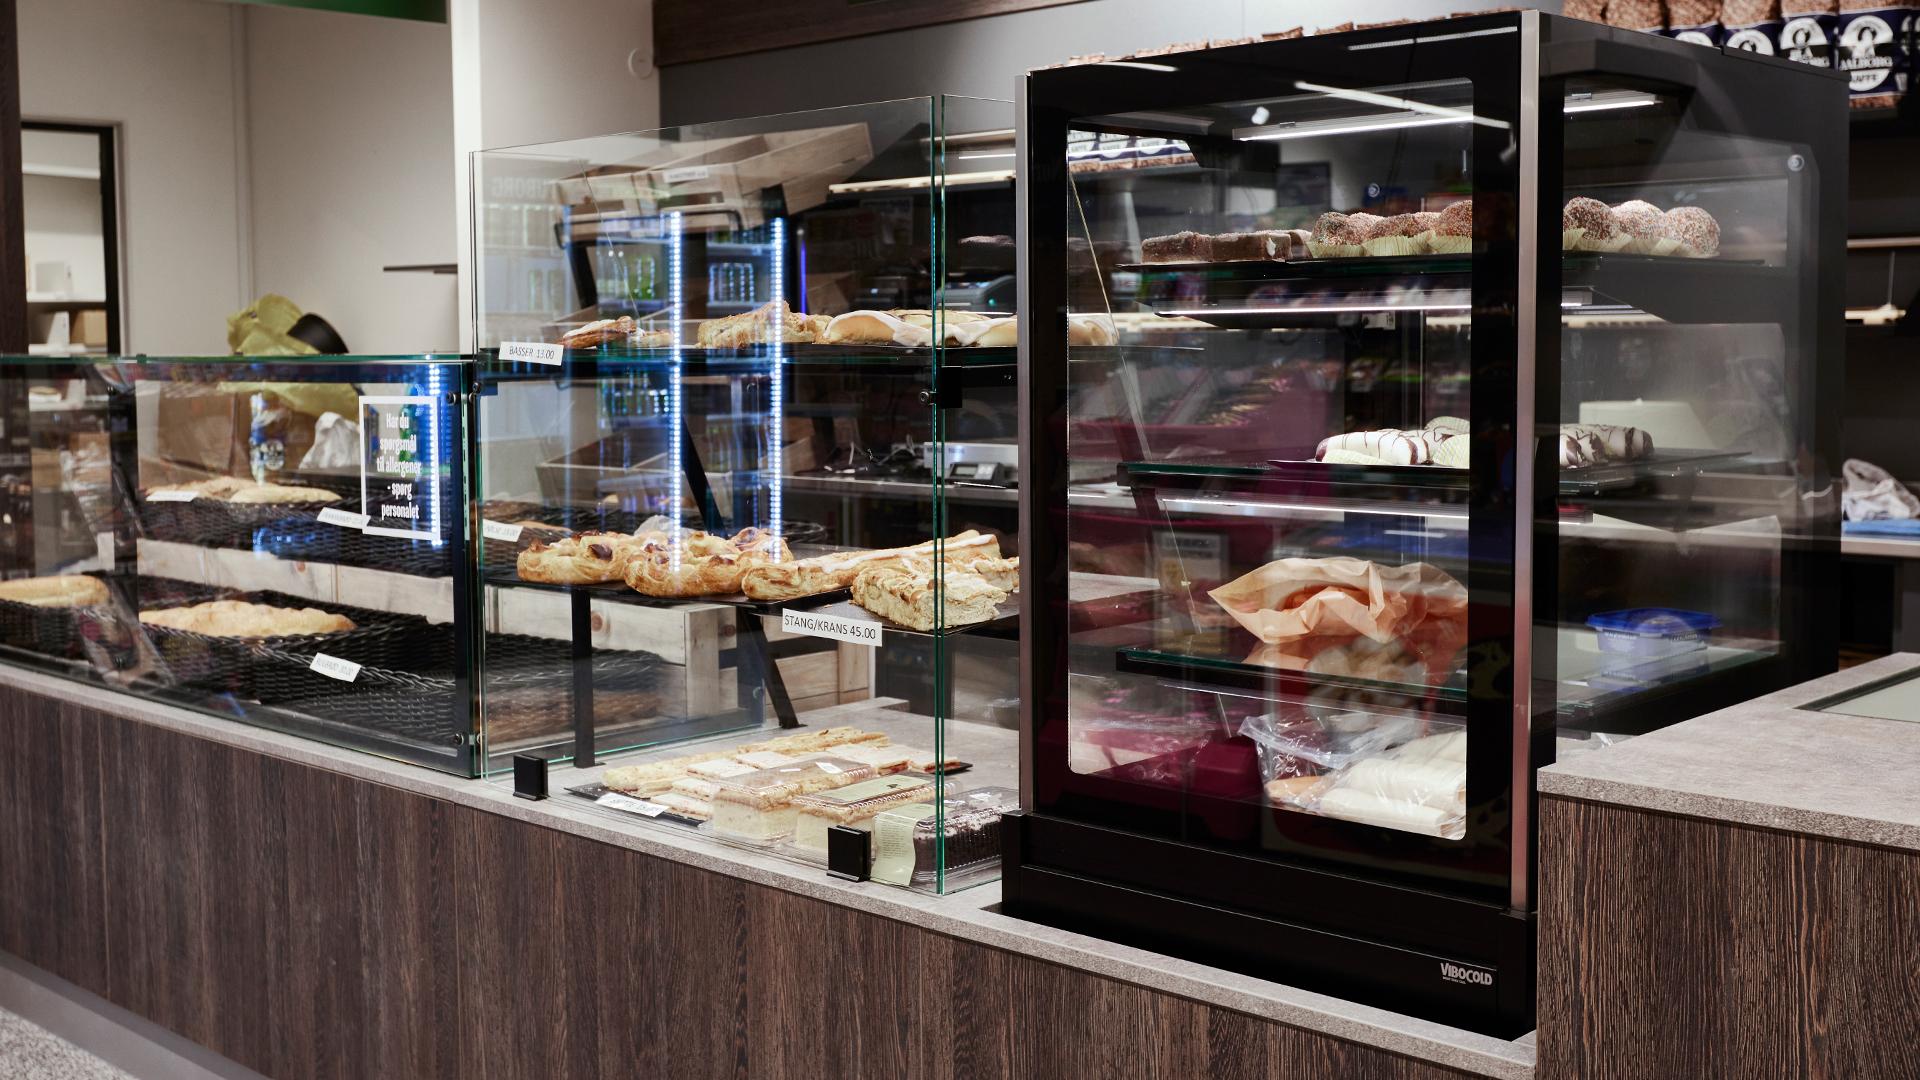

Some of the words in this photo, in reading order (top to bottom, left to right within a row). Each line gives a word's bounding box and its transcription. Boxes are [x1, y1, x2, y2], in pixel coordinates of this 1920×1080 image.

[509, 346, 533, 357] BASSER
[386, 412, 399, 428] Har
[400, 411, 410, 429] du
[376, 457, 385, 473] til
[385, 456, 422, 478] allergener
[381, 502, 419, 520] personalet
[784, 615, 848, 634] STANG/KRANS
[849, 625, 876, 640] 45.00
[1440, 962, 1492, 985] VIBOCOLD
